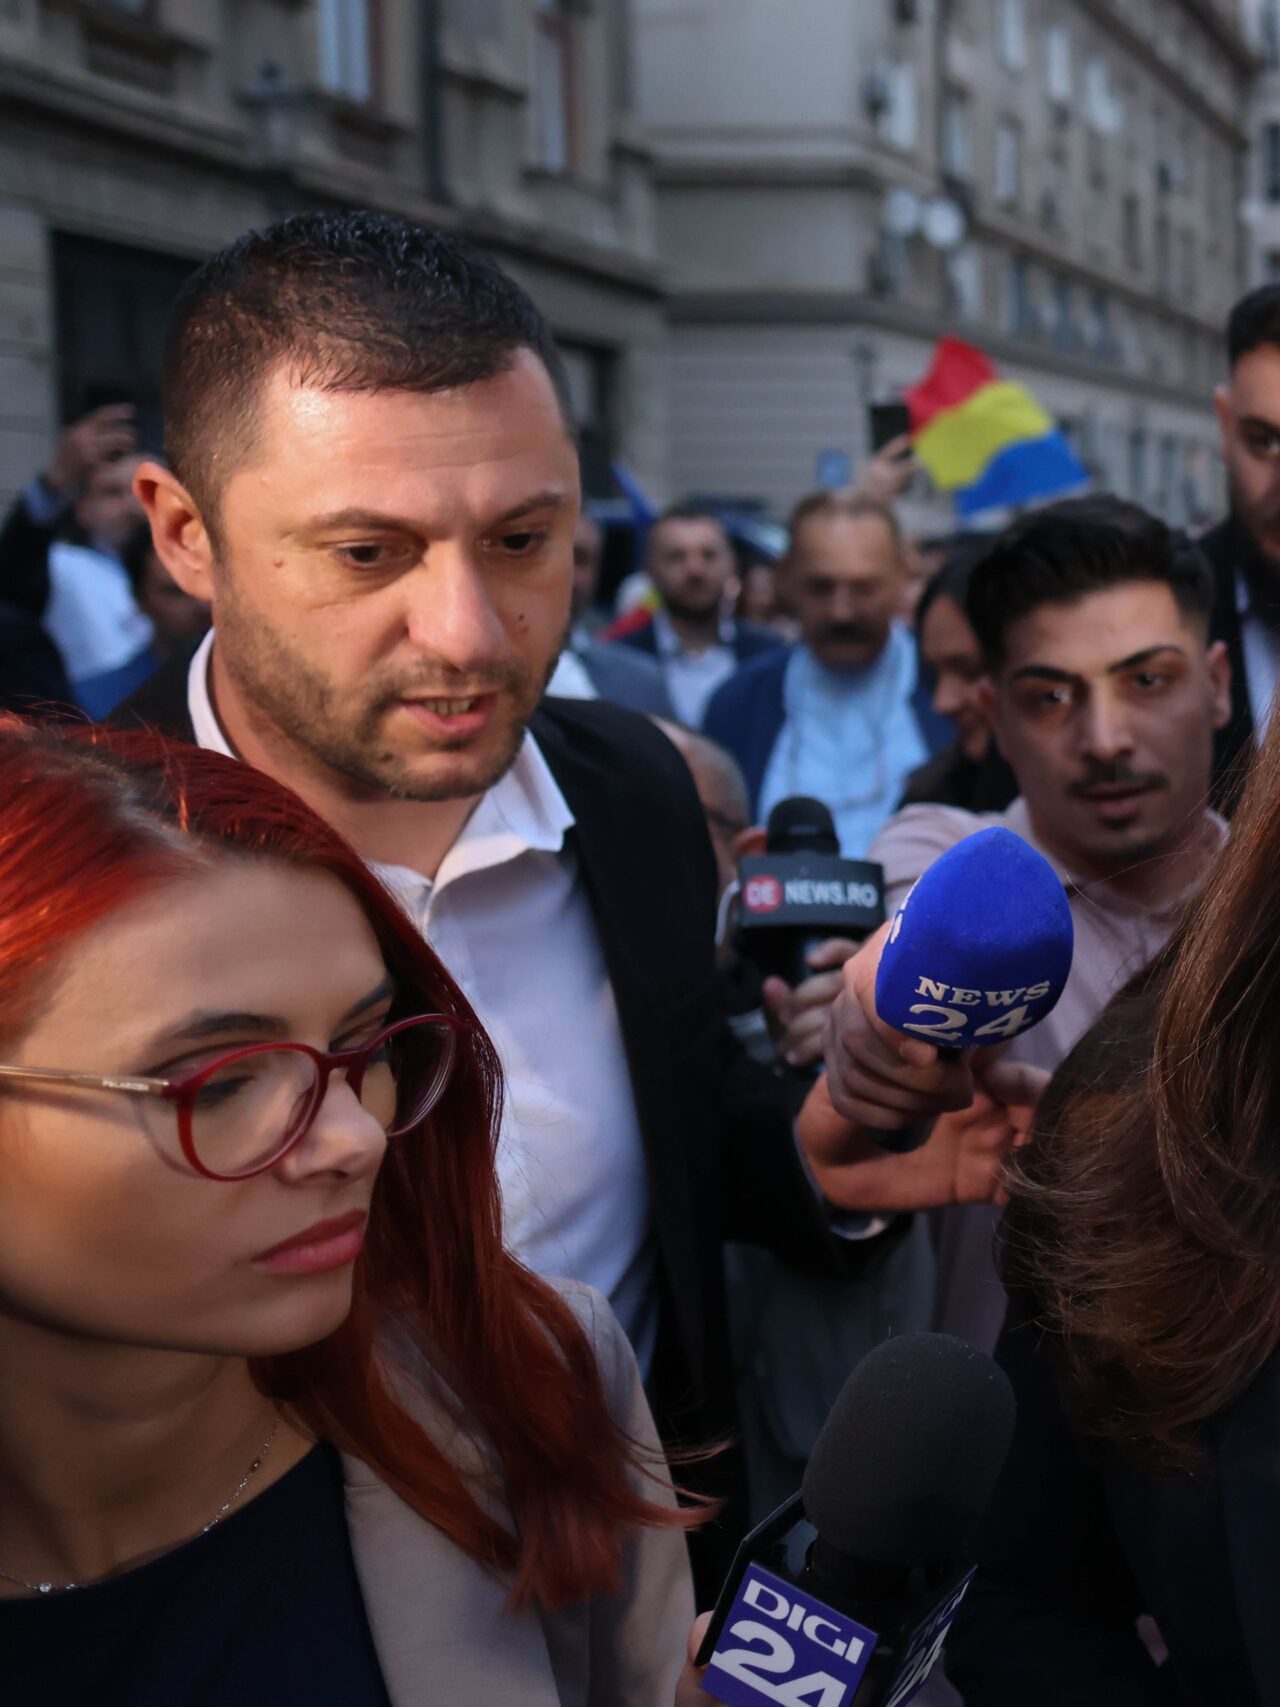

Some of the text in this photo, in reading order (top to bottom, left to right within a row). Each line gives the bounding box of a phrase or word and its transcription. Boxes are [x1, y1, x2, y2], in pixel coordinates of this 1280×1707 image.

[747, 881, 776, 906] DE
[784, 879, 879, 909] NEWS.RO
[914, 975, 1051, 1007] NEWS
[903, 1003, 1033, 1042] 24
[742, 1578, 865, 1665] DIGI
